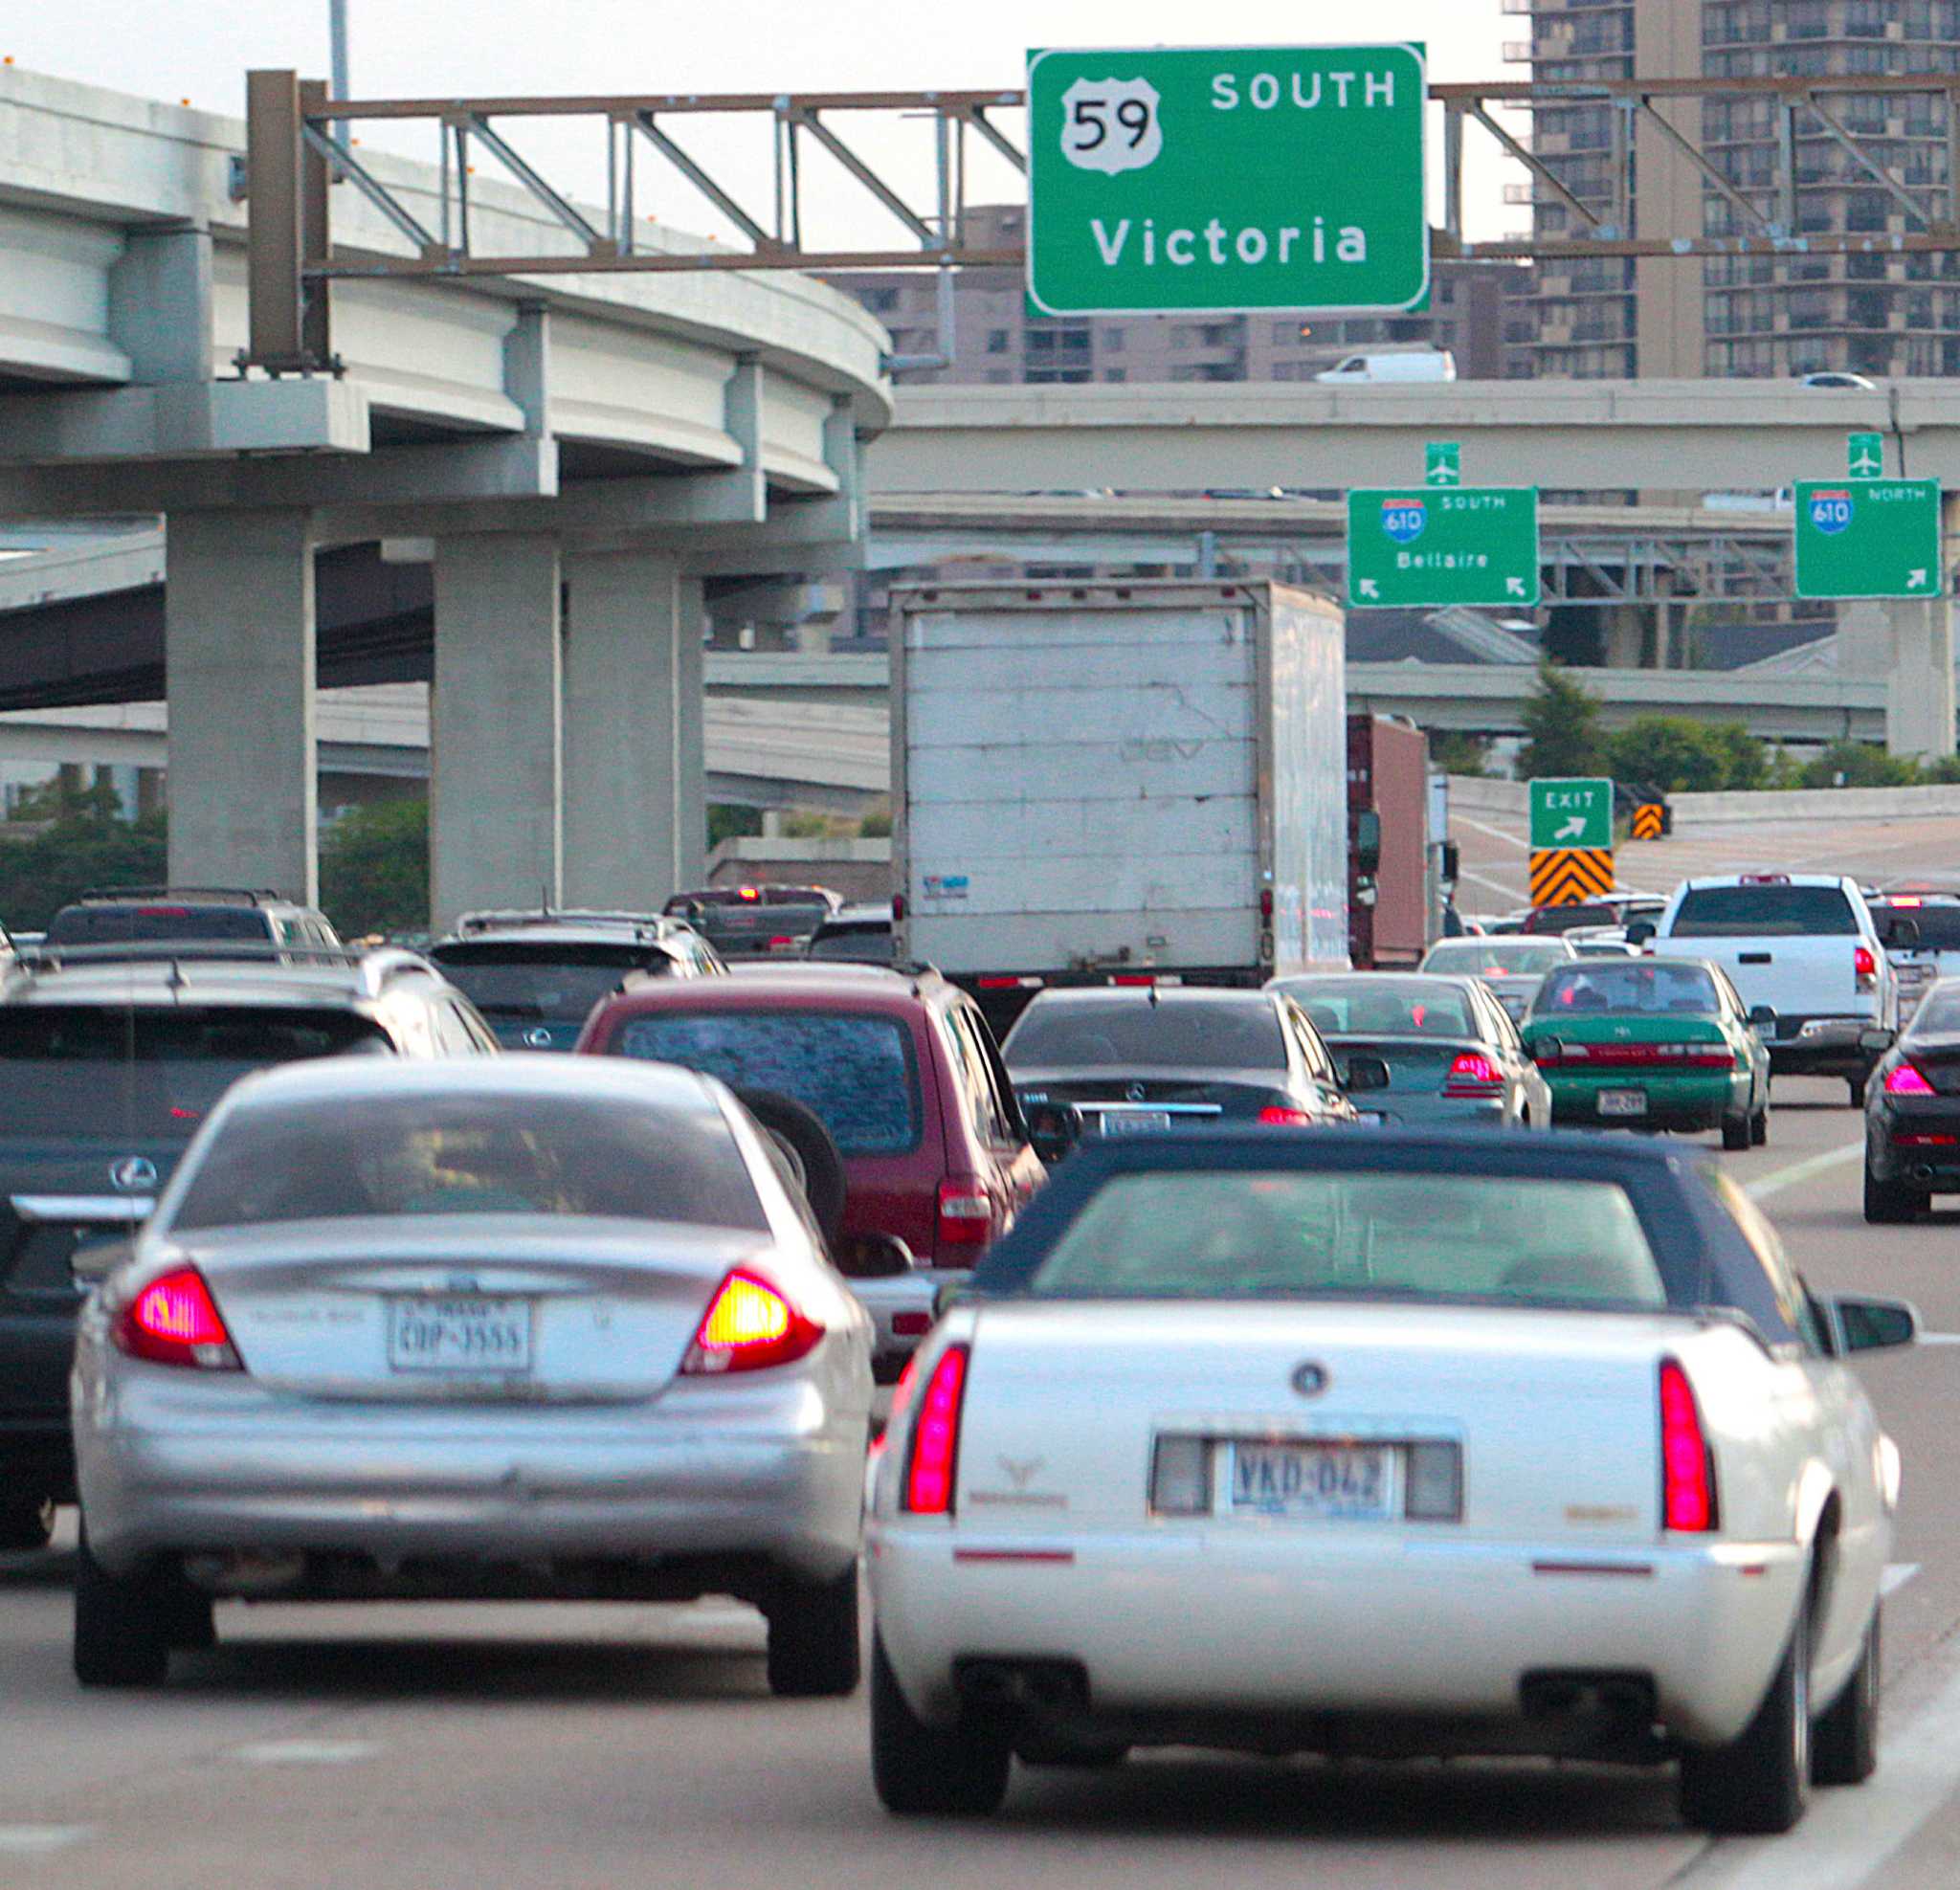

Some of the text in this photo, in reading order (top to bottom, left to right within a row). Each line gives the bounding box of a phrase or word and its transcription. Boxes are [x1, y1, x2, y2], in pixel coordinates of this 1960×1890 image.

[1211, 72, 1395, 110] SOUTH
[1074, 100, 1149, 151] 59
[1090, 216, 1367, 266] Victoria
[1441, 496, 1505, 510] SOUTH
[1868, 488, 1926, 502] NORTH
[1387, 510, 1422, 531] 610
[1813, 502, 1849, 523] 610
[1396, 551, 1488, 568] Bellaire
[1546, 791, 1594, 809] EXIT
